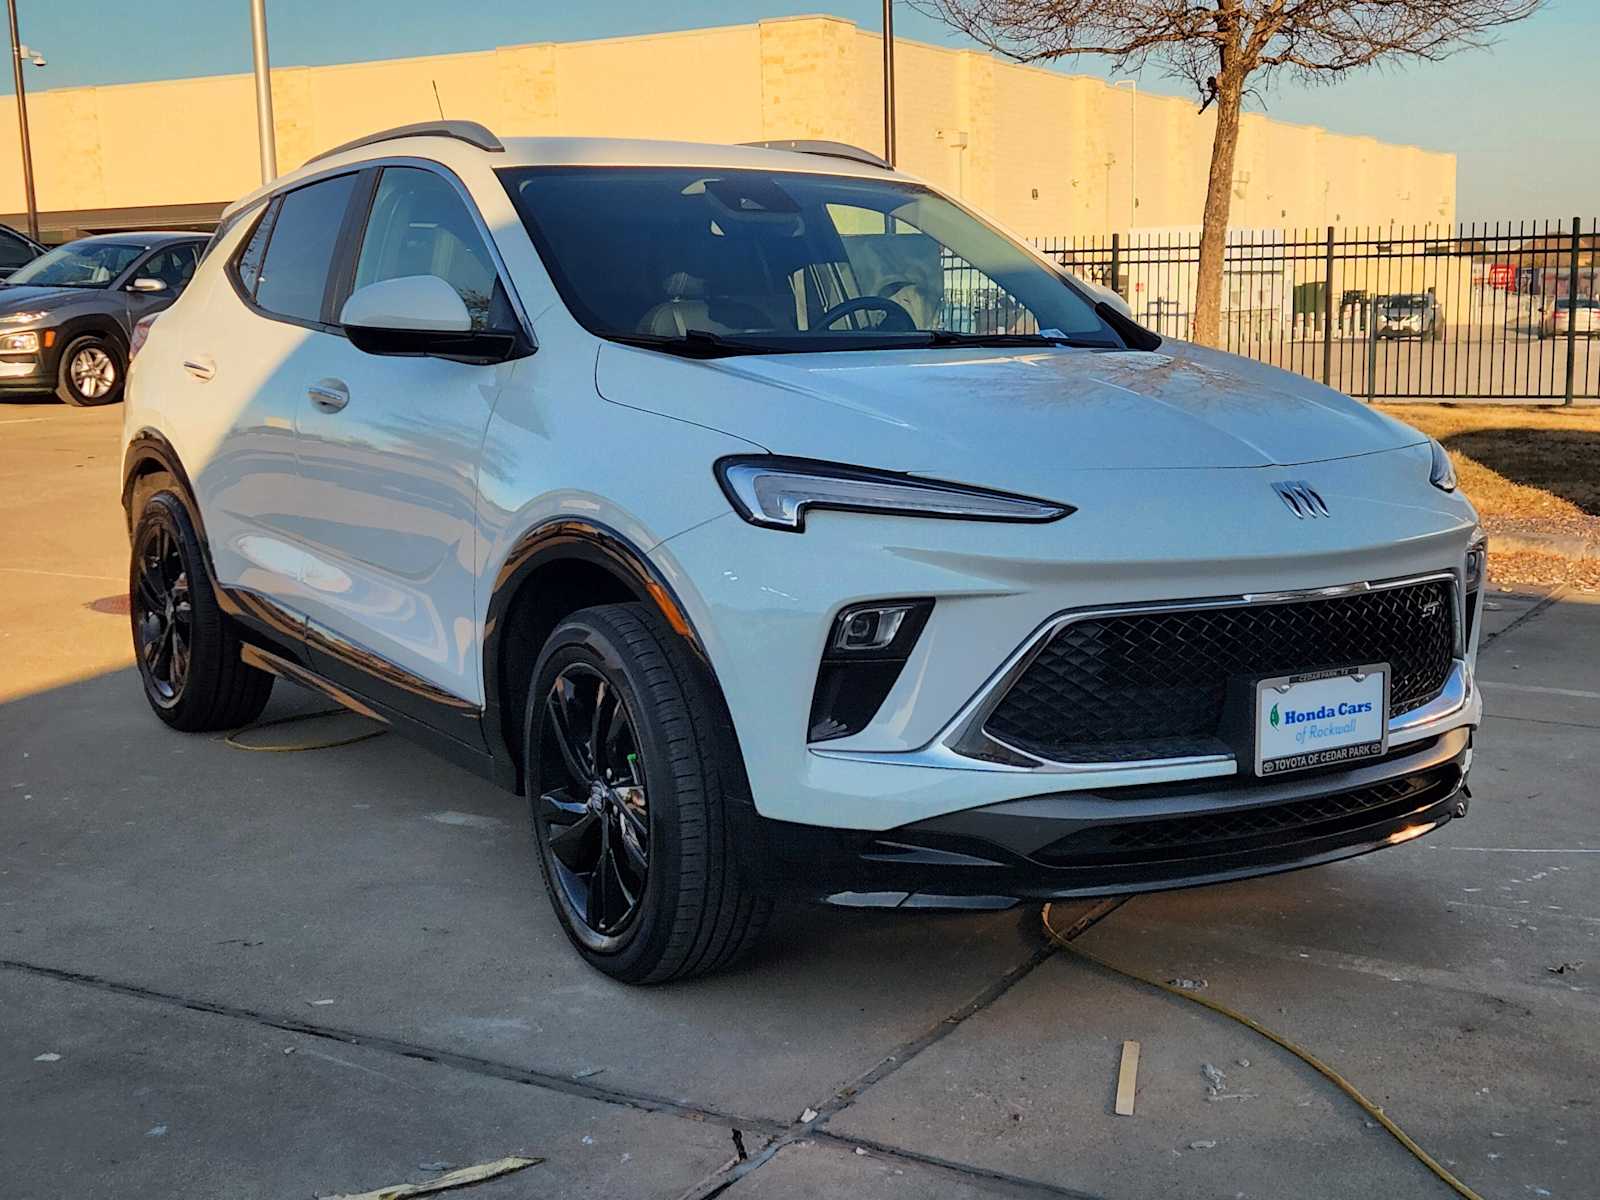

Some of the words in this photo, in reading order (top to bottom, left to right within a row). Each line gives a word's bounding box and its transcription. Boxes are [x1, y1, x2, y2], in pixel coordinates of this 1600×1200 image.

[1284, 705, 1335, 725] Honda
[1338, 702, 1372, 716] Cars
[1295, 728, 1308, 744] of
[1309, 719, 1357, 739] Rockwall
[1274, 755, 1307, 771] TOYOTA
[1307, 753, 1319, 765] OF
[1320, 749, 1347, 763] CEDAR
[1348, 744, 1371, 758] PARK
